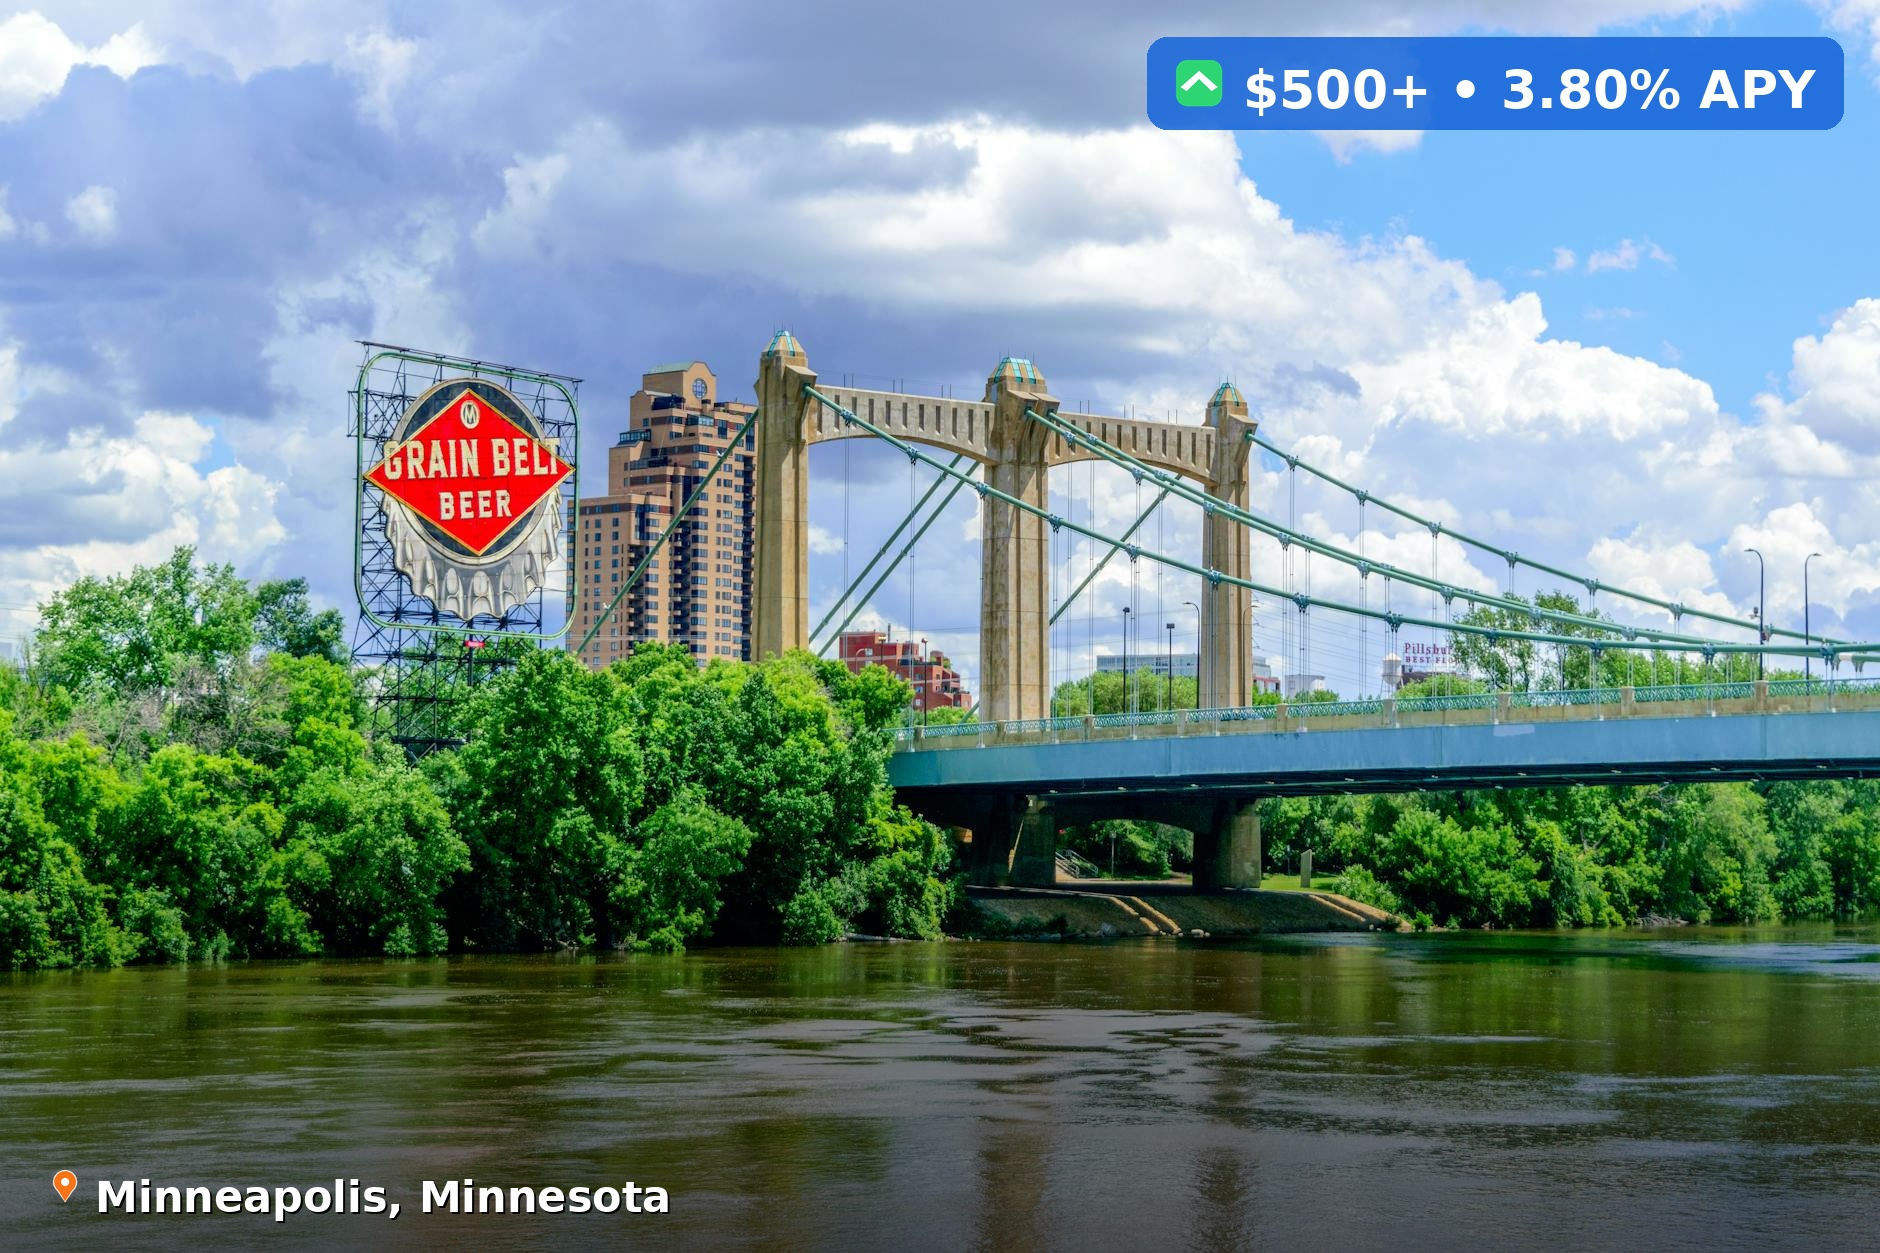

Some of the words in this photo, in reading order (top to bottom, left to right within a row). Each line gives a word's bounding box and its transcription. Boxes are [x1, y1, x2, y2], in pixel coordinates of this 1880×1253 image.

[384, 438, 481, 480] GRAIN
[491, 437, 561, 476] BELT
[439, 490, 512, 521] BEER
[1404, 642, 1453, 655] Pillsbur
[1405, 655, 1430, 664] BEST
[1435, 656, 1457, 664] FLO
